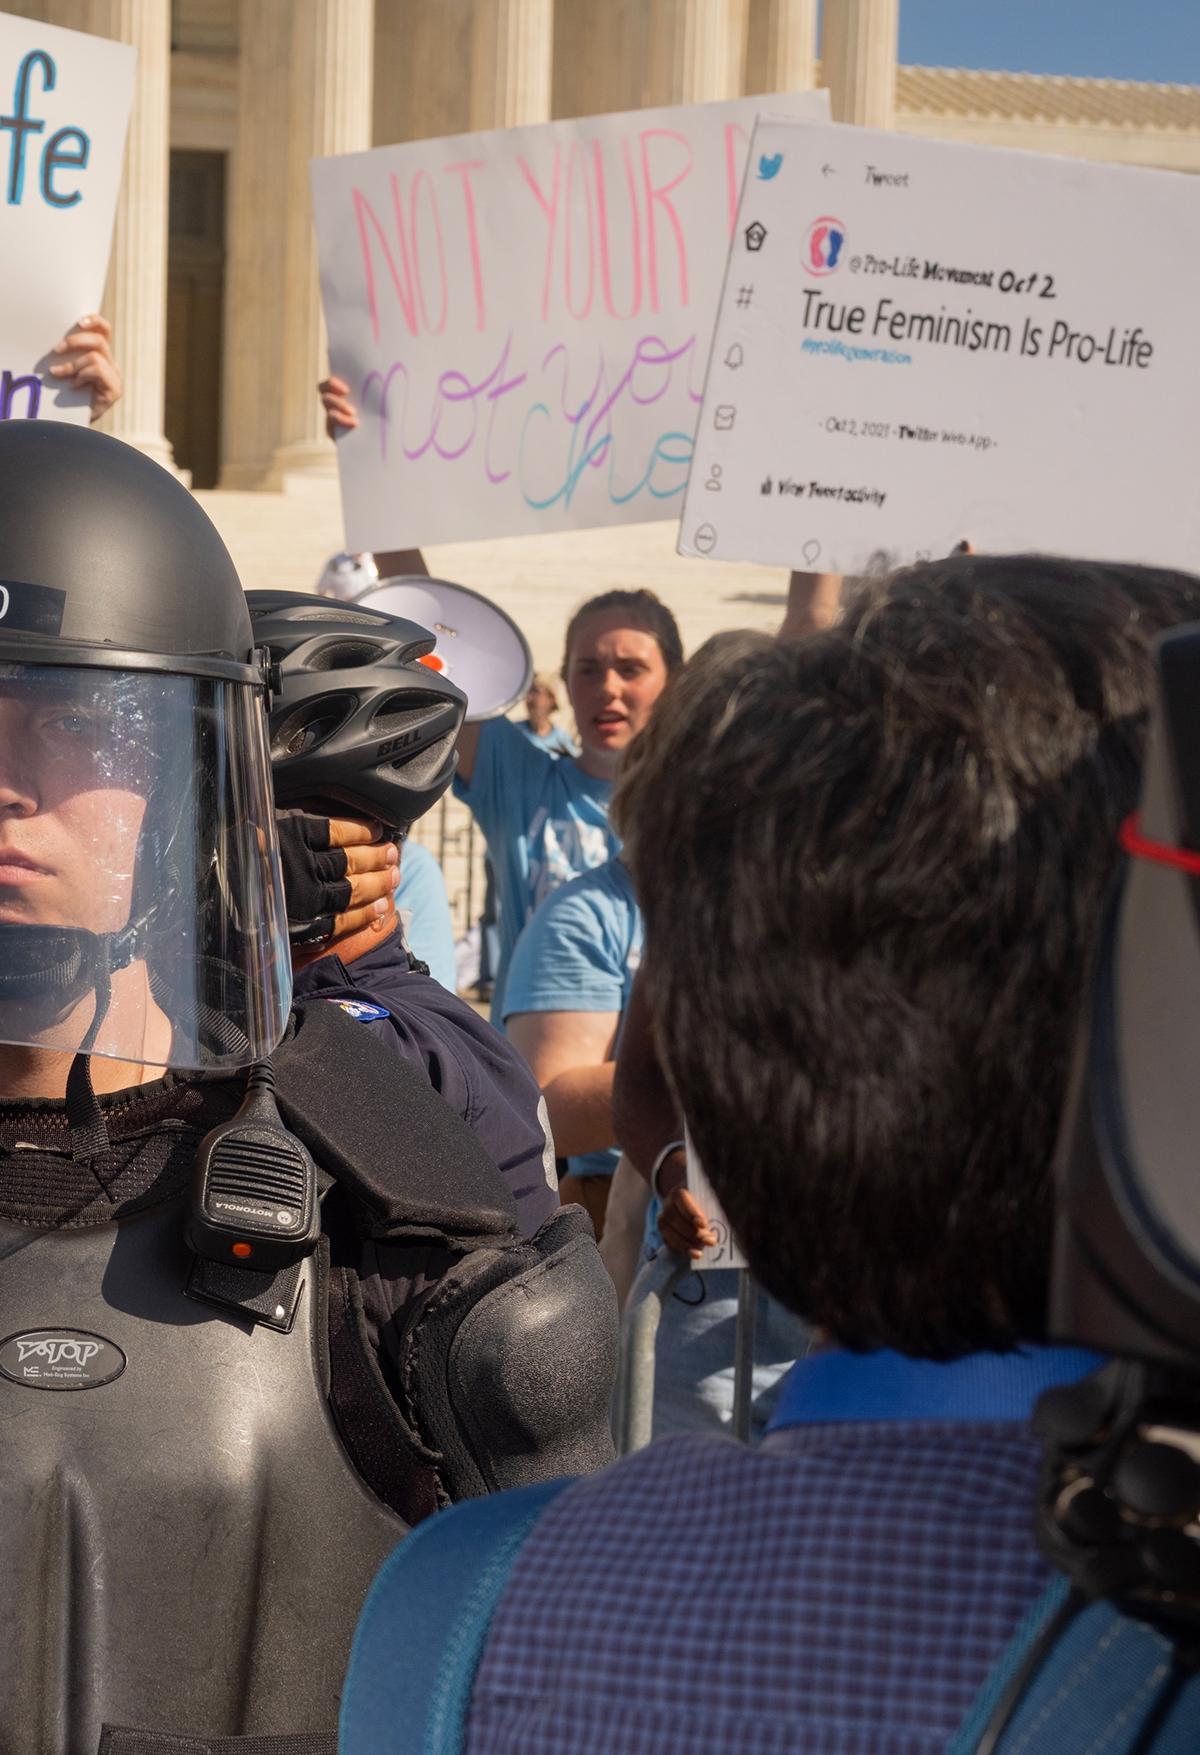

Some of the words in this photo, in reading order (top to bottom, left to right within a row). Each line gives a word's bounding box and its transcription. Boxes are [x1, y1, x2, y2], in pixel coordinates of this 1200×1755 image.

[864, 165, 910, 188] Tweet
[351, 158, 487, 344] NOT
[516, 128, 696, 324] YOUR
[998, 270, 1038, 293] Oct
[1039, 274, 1057, 298] 2
[801, 289, 865, 335] True
[872, 299, 1011, 352] Feminism
[1021, 317, 1043, 356] Is
[1048, 320, 1154, 369] Pro-Life
[361, 327, 528, 484] not
[376, 729, 422, 758] BELL
[215, 1202, 274, 1217] MOTOROLA
